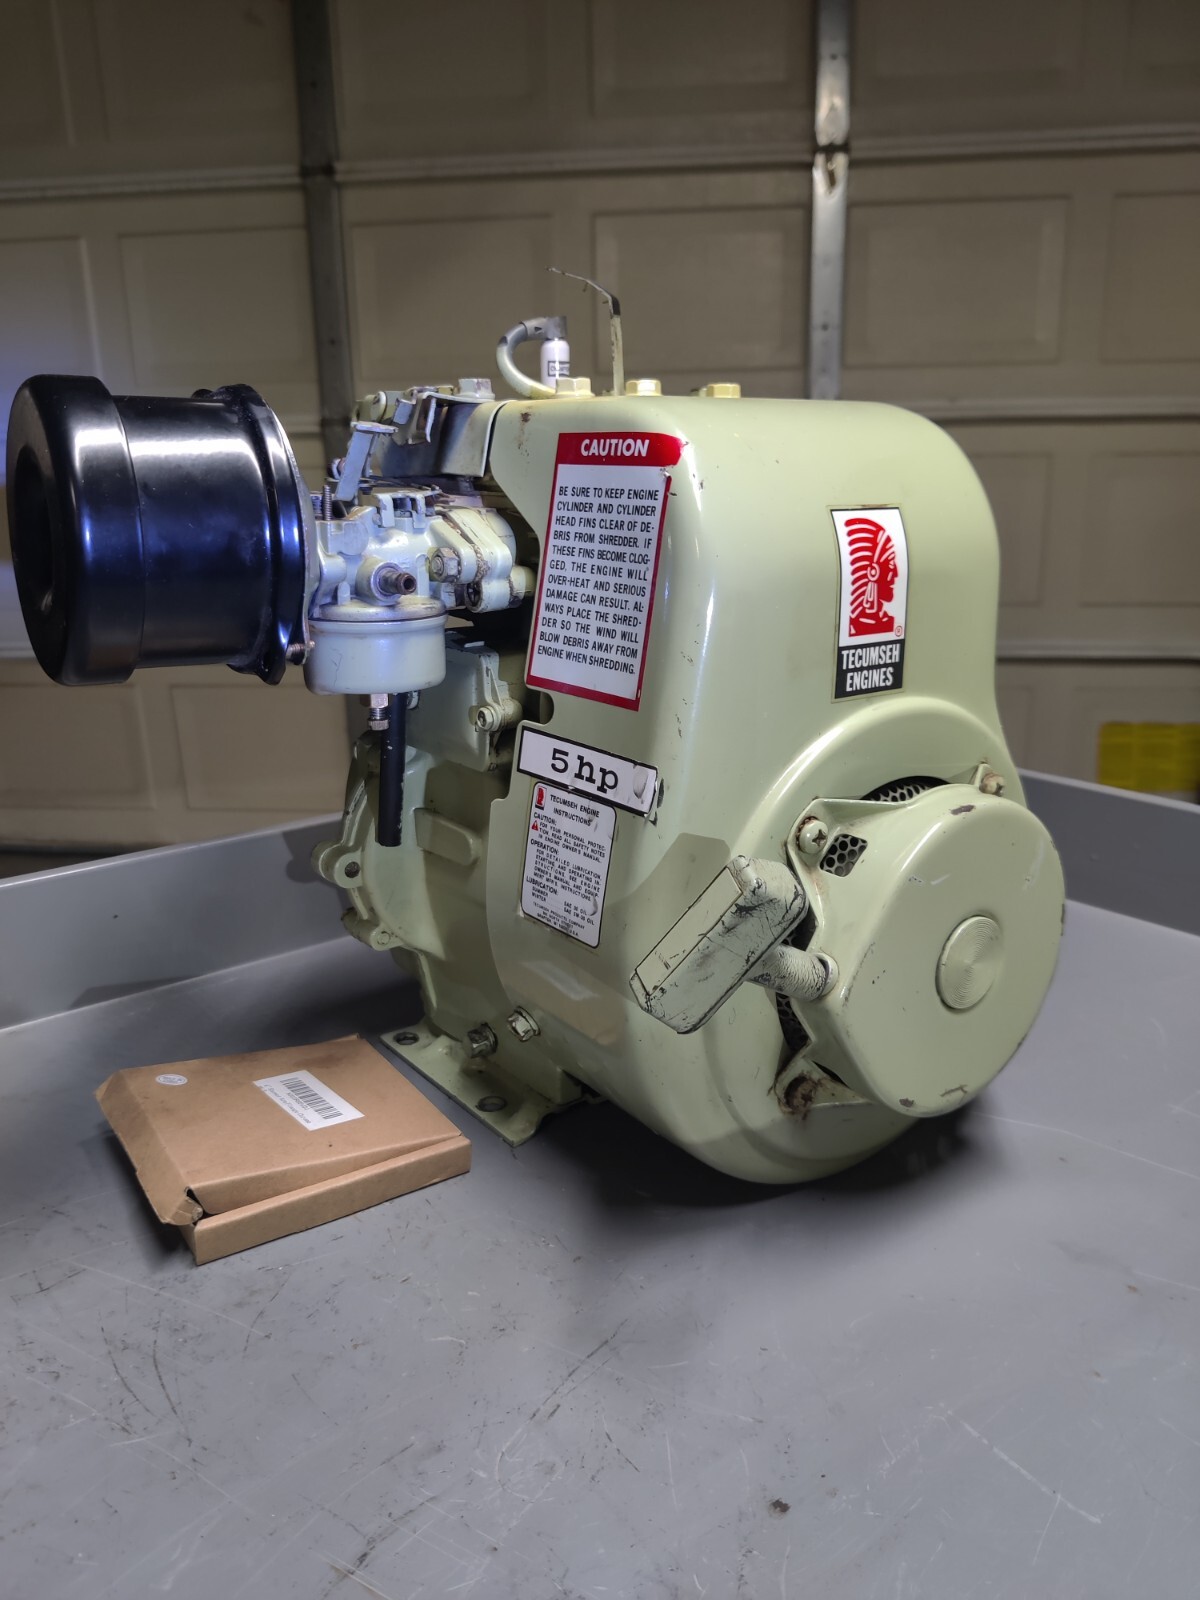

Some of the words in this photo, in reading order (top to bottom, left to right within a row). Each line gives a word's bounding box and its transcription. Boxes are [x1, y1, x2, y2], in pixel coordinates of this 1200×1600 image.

[581, 439, 649, 457] CAUTION
[559, 486, 568, 496] BE
[571, 487, 590, 497] SURE
[592, 488, 603, 497] TO
[605, 488, 625, 499] KEEP
[628, 489, 659, 500] ENGINE
[557, 501, 594, 512] CYLINDER
[597, 503, 614, 514] AND
[616, 504, 656, 517] CYLINDER
[555, 516, 576, 526] HEAD
[579, 518, 596, 528] FINS
[599, 519, 625, 530] CLEAR
[627, 521, 638, 531] OF
[640, 522, 655, 533] DE-
[553, 530, 571, 541] BRIS
[574, 532, 595, 543] FROM
[598, 534, 640, 548] SHREDDER.
[644, 538, 652, 549] IF
[552, 545, 576, 556] THESE
[578, 548, 595, 558] FINS
[597, 550, 627, 562] BECOME
[628, 553, 651, 565] CLOG-
[549, 559, 568, 570] GED,
[571, 562, 587, 573] THE
[591, 564, 623, 578] ENGINE
[627, 569, 648, 581] WILL
[548, 574, 590, 589] OVER-HEAT
[593, 580, 611, 592] AND
[613, 583, 646, 597] SERIOUS
[546, 588, 578, 602] DAMAGE
[580, 593, 596, 605] CAN
[599, 596, 631, 610] RESULT.
[633, 602, 644, 612] AL-
[544, 602, 564, 614] WAYS
[566, 606, 591, 619] PLACE
[594, 611, 610, 622] THE
[612, 614, 642, 628] SHRED-
[542, 617, 557, 628] DER
[560, 620, 571, 631] SO
[575, 623, 591, 634] THE
[596, 626, 617, 639] WIND
[620, 631, 639, 643] WILL
[540, 631, 560, 643] BLOW
[563, 635, 589, 649] DEBRIS
[592, 641, 614, 654] AWAY
[615, 645, 638, 659] FROM
[538, 645, 564, 659] ENGINE
[565, 651, 587, 664] WHEN
[589, 655, 636, 674] SHREDDING.
[842, 644, 900, 670] TECUMSEH
[846, 667, 894, 692] ENGINES
[550, 794, 577, 810] TECUMSEH
[580, 805, 599, 818] ENGINE
[553, 808, 591, 826] INSTRUCTIONS
[545, 836, 560, 846] ENGINE
[550, 826, 561, 834] YOUR
[563, 831, 585, 843] PERSONAL
[530, 838, 559, 855] OPERATION:
[552, 833, 562, 841] READ
[573, 841, 589, 851] SAFETY
[591, 848, 605, 858] NOTES
[536, 854, 555, 866] STARTING
[568, 868, 592, 882] OPERATING
[546, 853, 570, 866] DETAILED
[554, 875, 571, 886] MANUAL
[573, 883, 582, 891] AND
[581, 880, 600, 893] ENGINE
